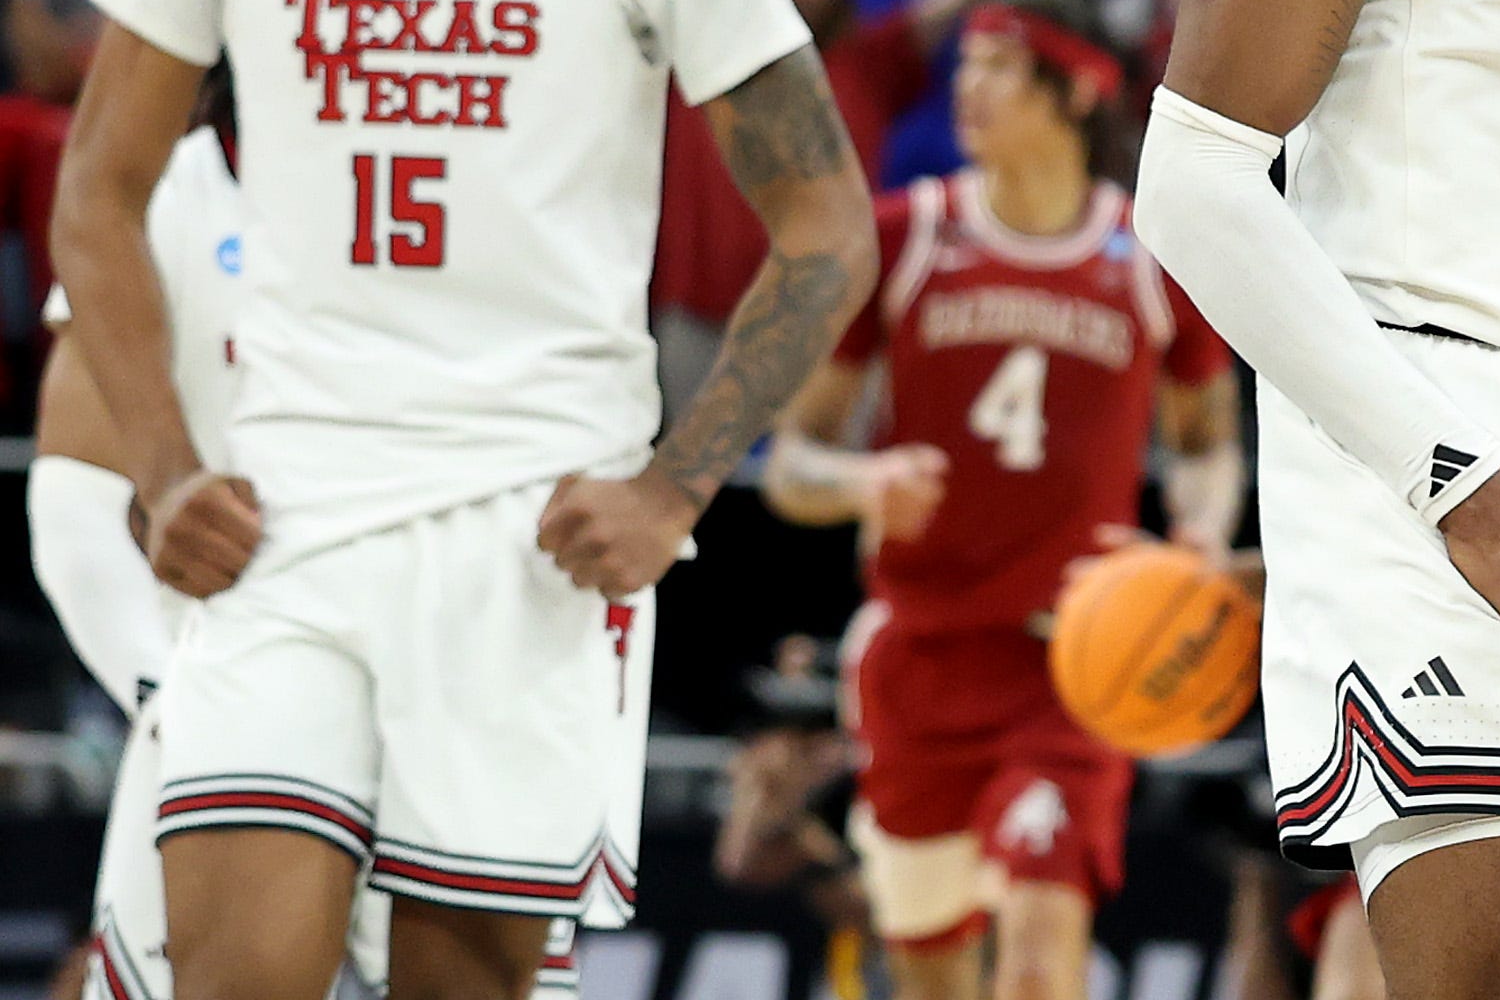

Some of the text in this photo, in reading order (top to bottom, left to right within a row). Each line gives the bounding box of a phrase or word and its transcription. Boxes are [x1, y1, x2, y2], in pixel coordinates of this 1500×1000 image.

[304, 50, 509, 128] TECH
[351, 154, 446, 267] 15
[969, 345, 1049, 471] 4
